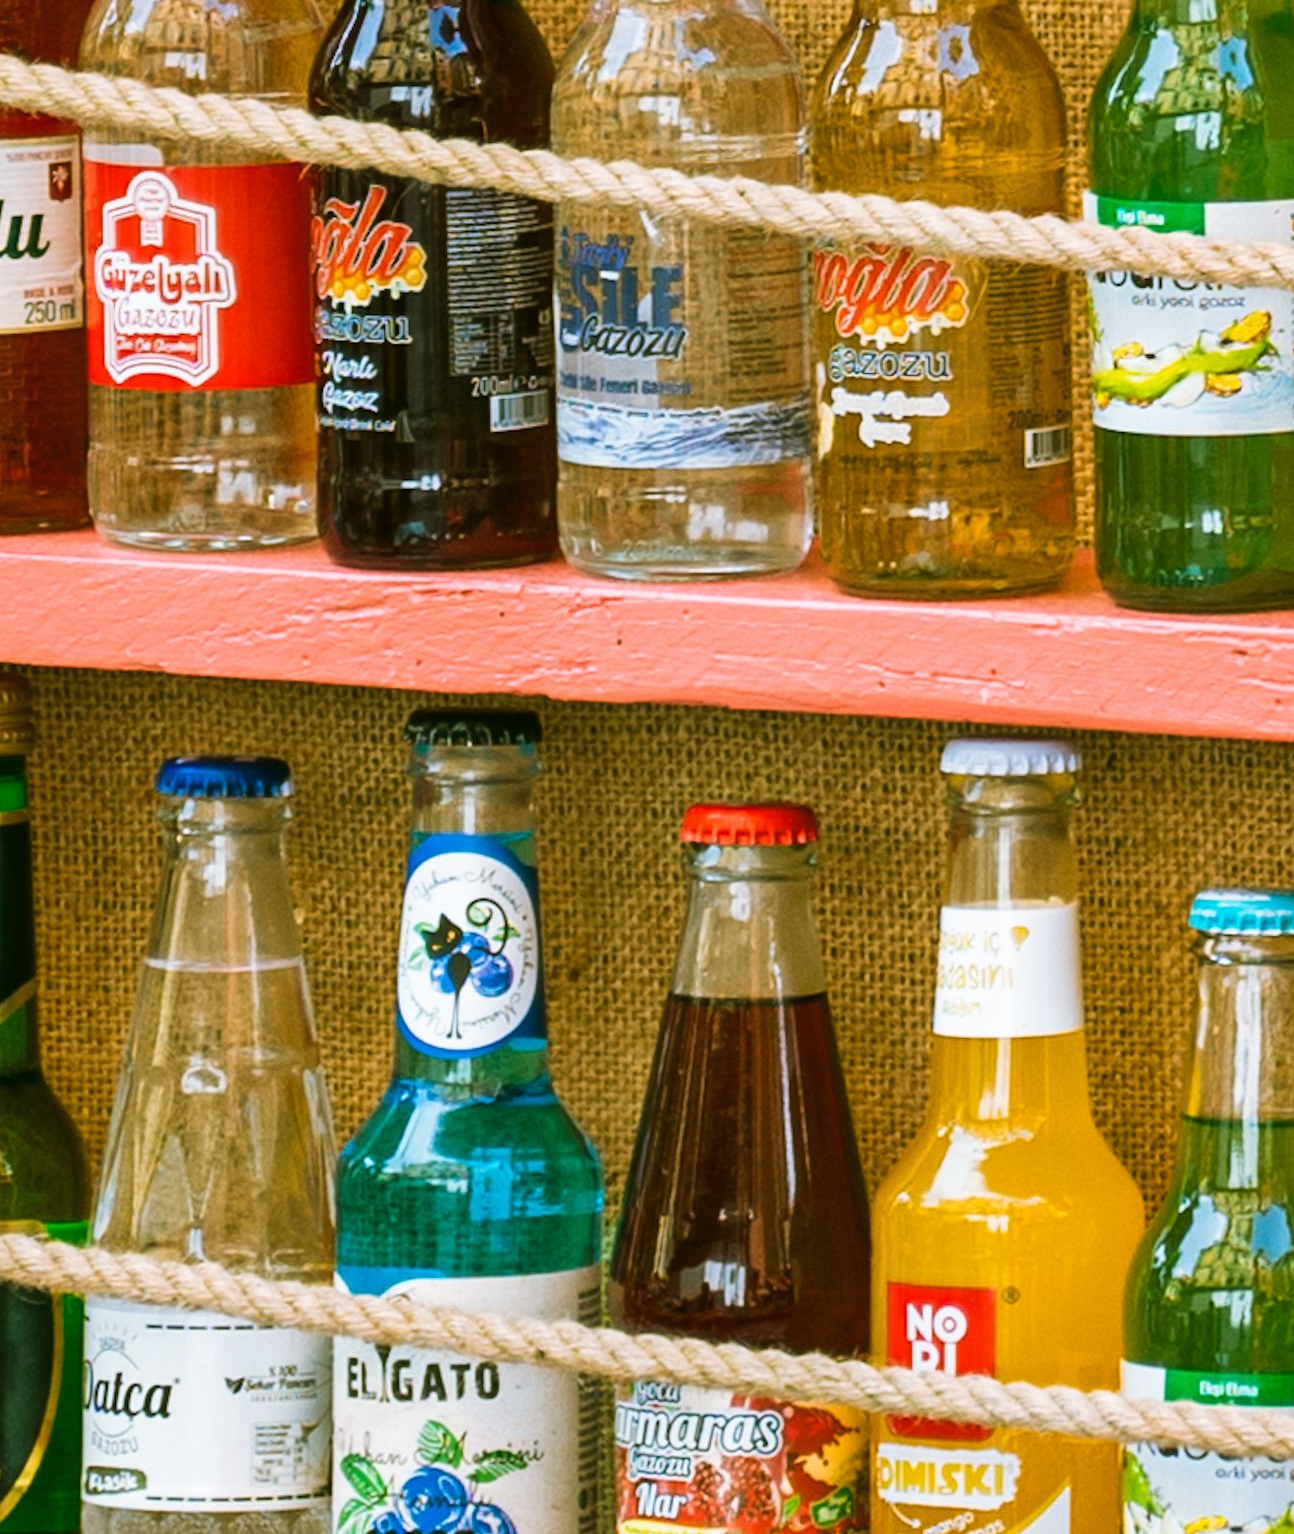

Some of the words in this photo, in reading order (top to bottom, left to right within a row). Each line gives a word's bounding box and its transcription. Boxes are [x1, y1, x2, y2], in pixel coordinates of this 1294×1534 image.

[25, 301, 56, 325] 250
[60, 298, 76, 322] ml
[118, 297, 197, 329] Gazozu
[580, 316, 687, 359] Gazozu
[906, 1303, 968, 1344] NO
[347, 1357, 367, 1399] EL
[391, 1359, 500, 1402] GATO
[636, 1482, 688, 1519] Nar
